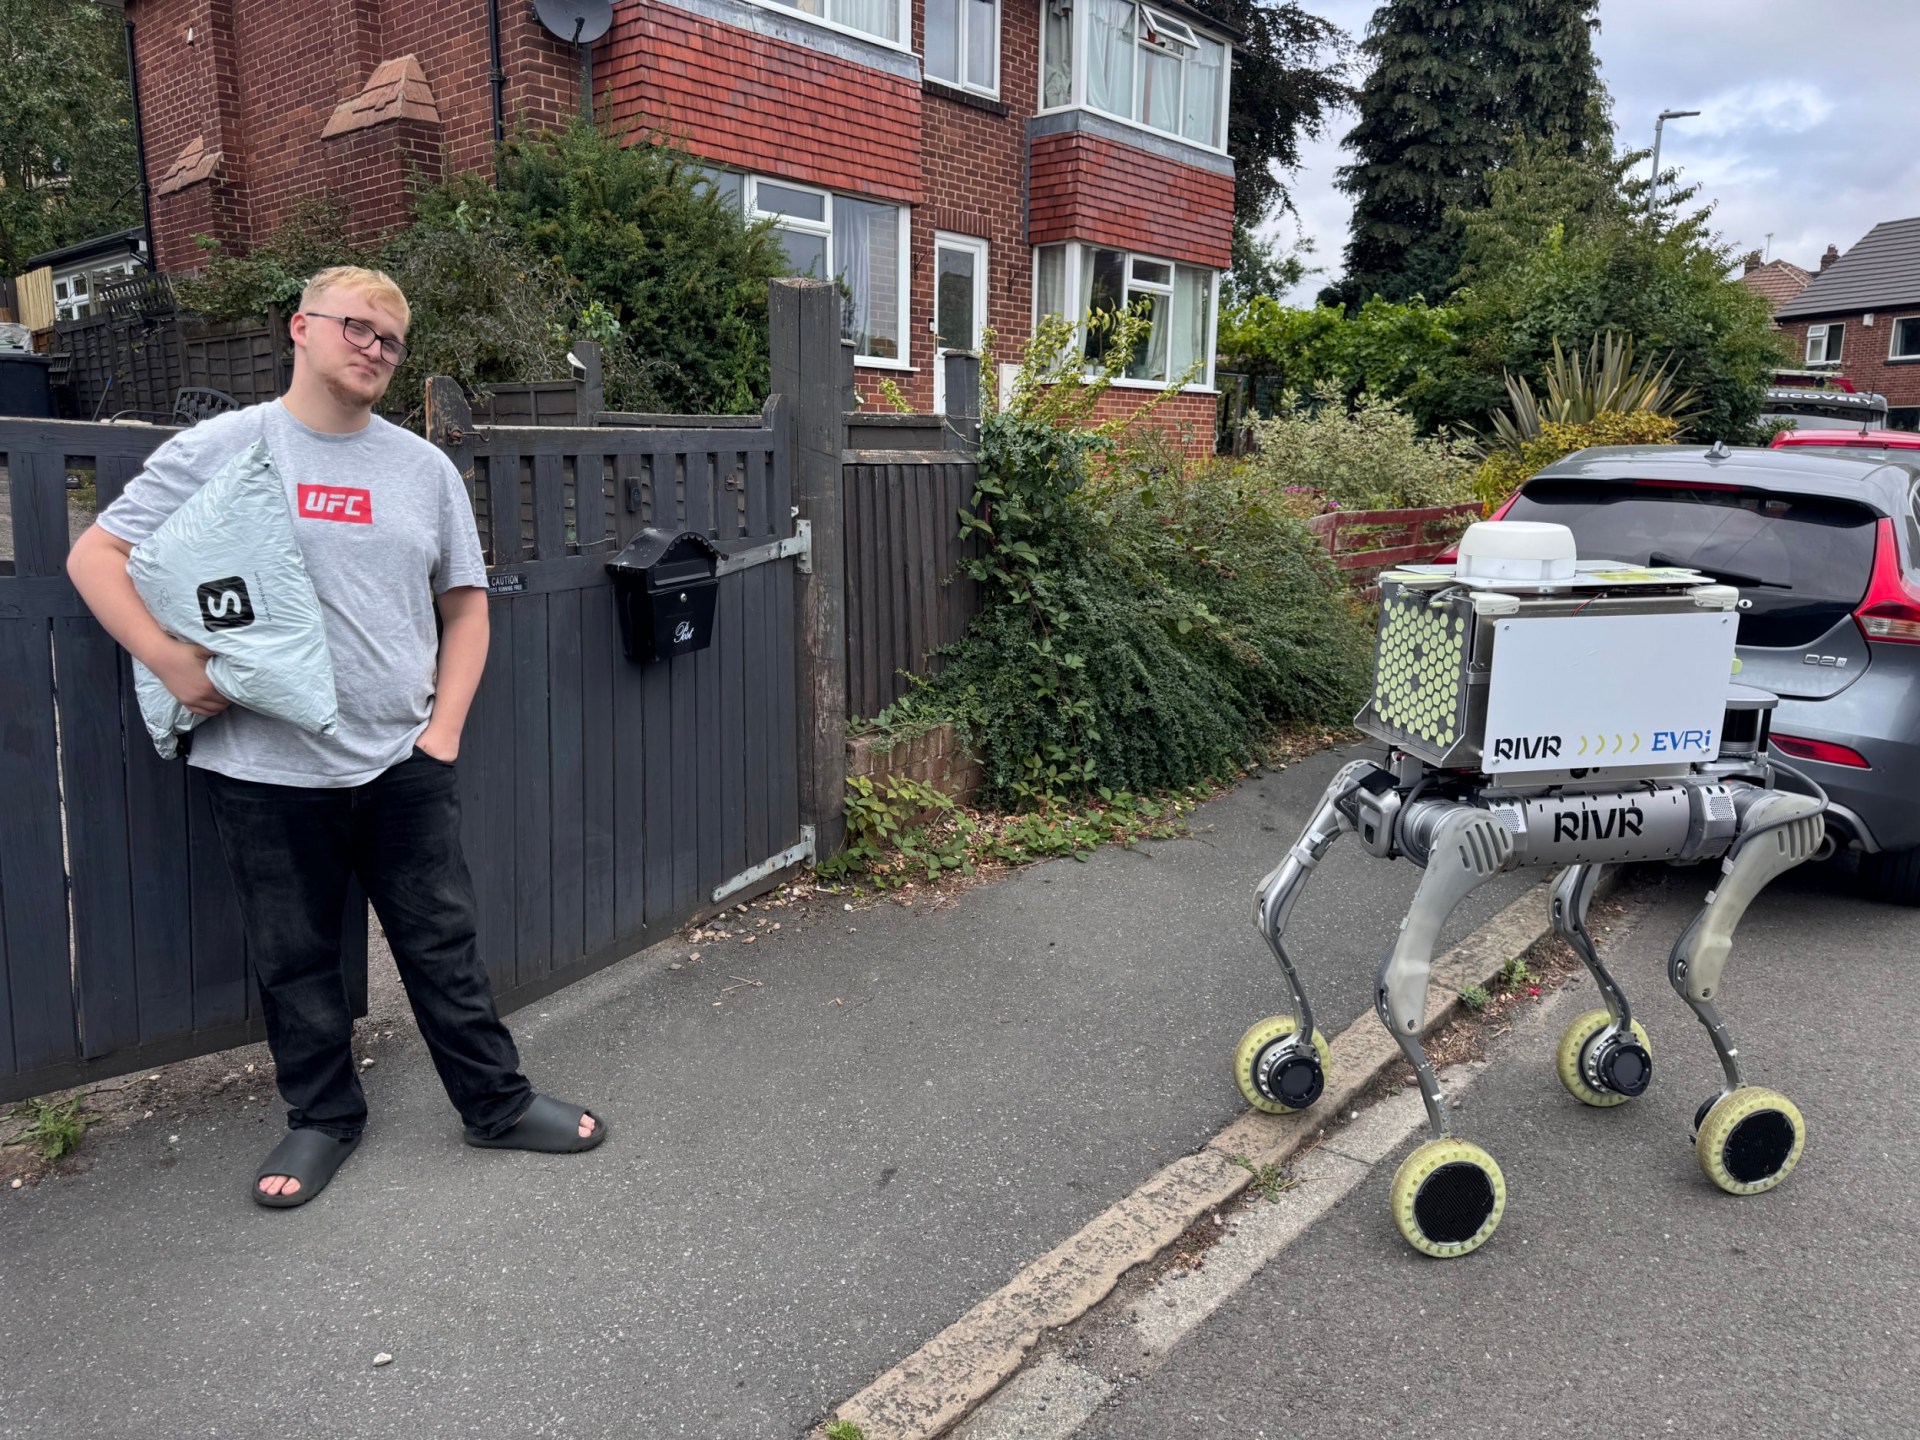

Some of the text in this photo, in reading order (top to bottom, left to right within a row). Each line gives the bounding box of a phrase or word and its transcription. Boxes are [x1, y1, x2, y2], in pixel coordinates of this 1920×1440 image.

[305, 491, 364, 517] UFC
[491, 574, 519, 587] CAUTION
[207, 590, 242, 618] S
[673, 620, 695, 643] Post
[1494, 735, 1562, 760] RIVR
[1554, 807, 1644, 843] RIVR
